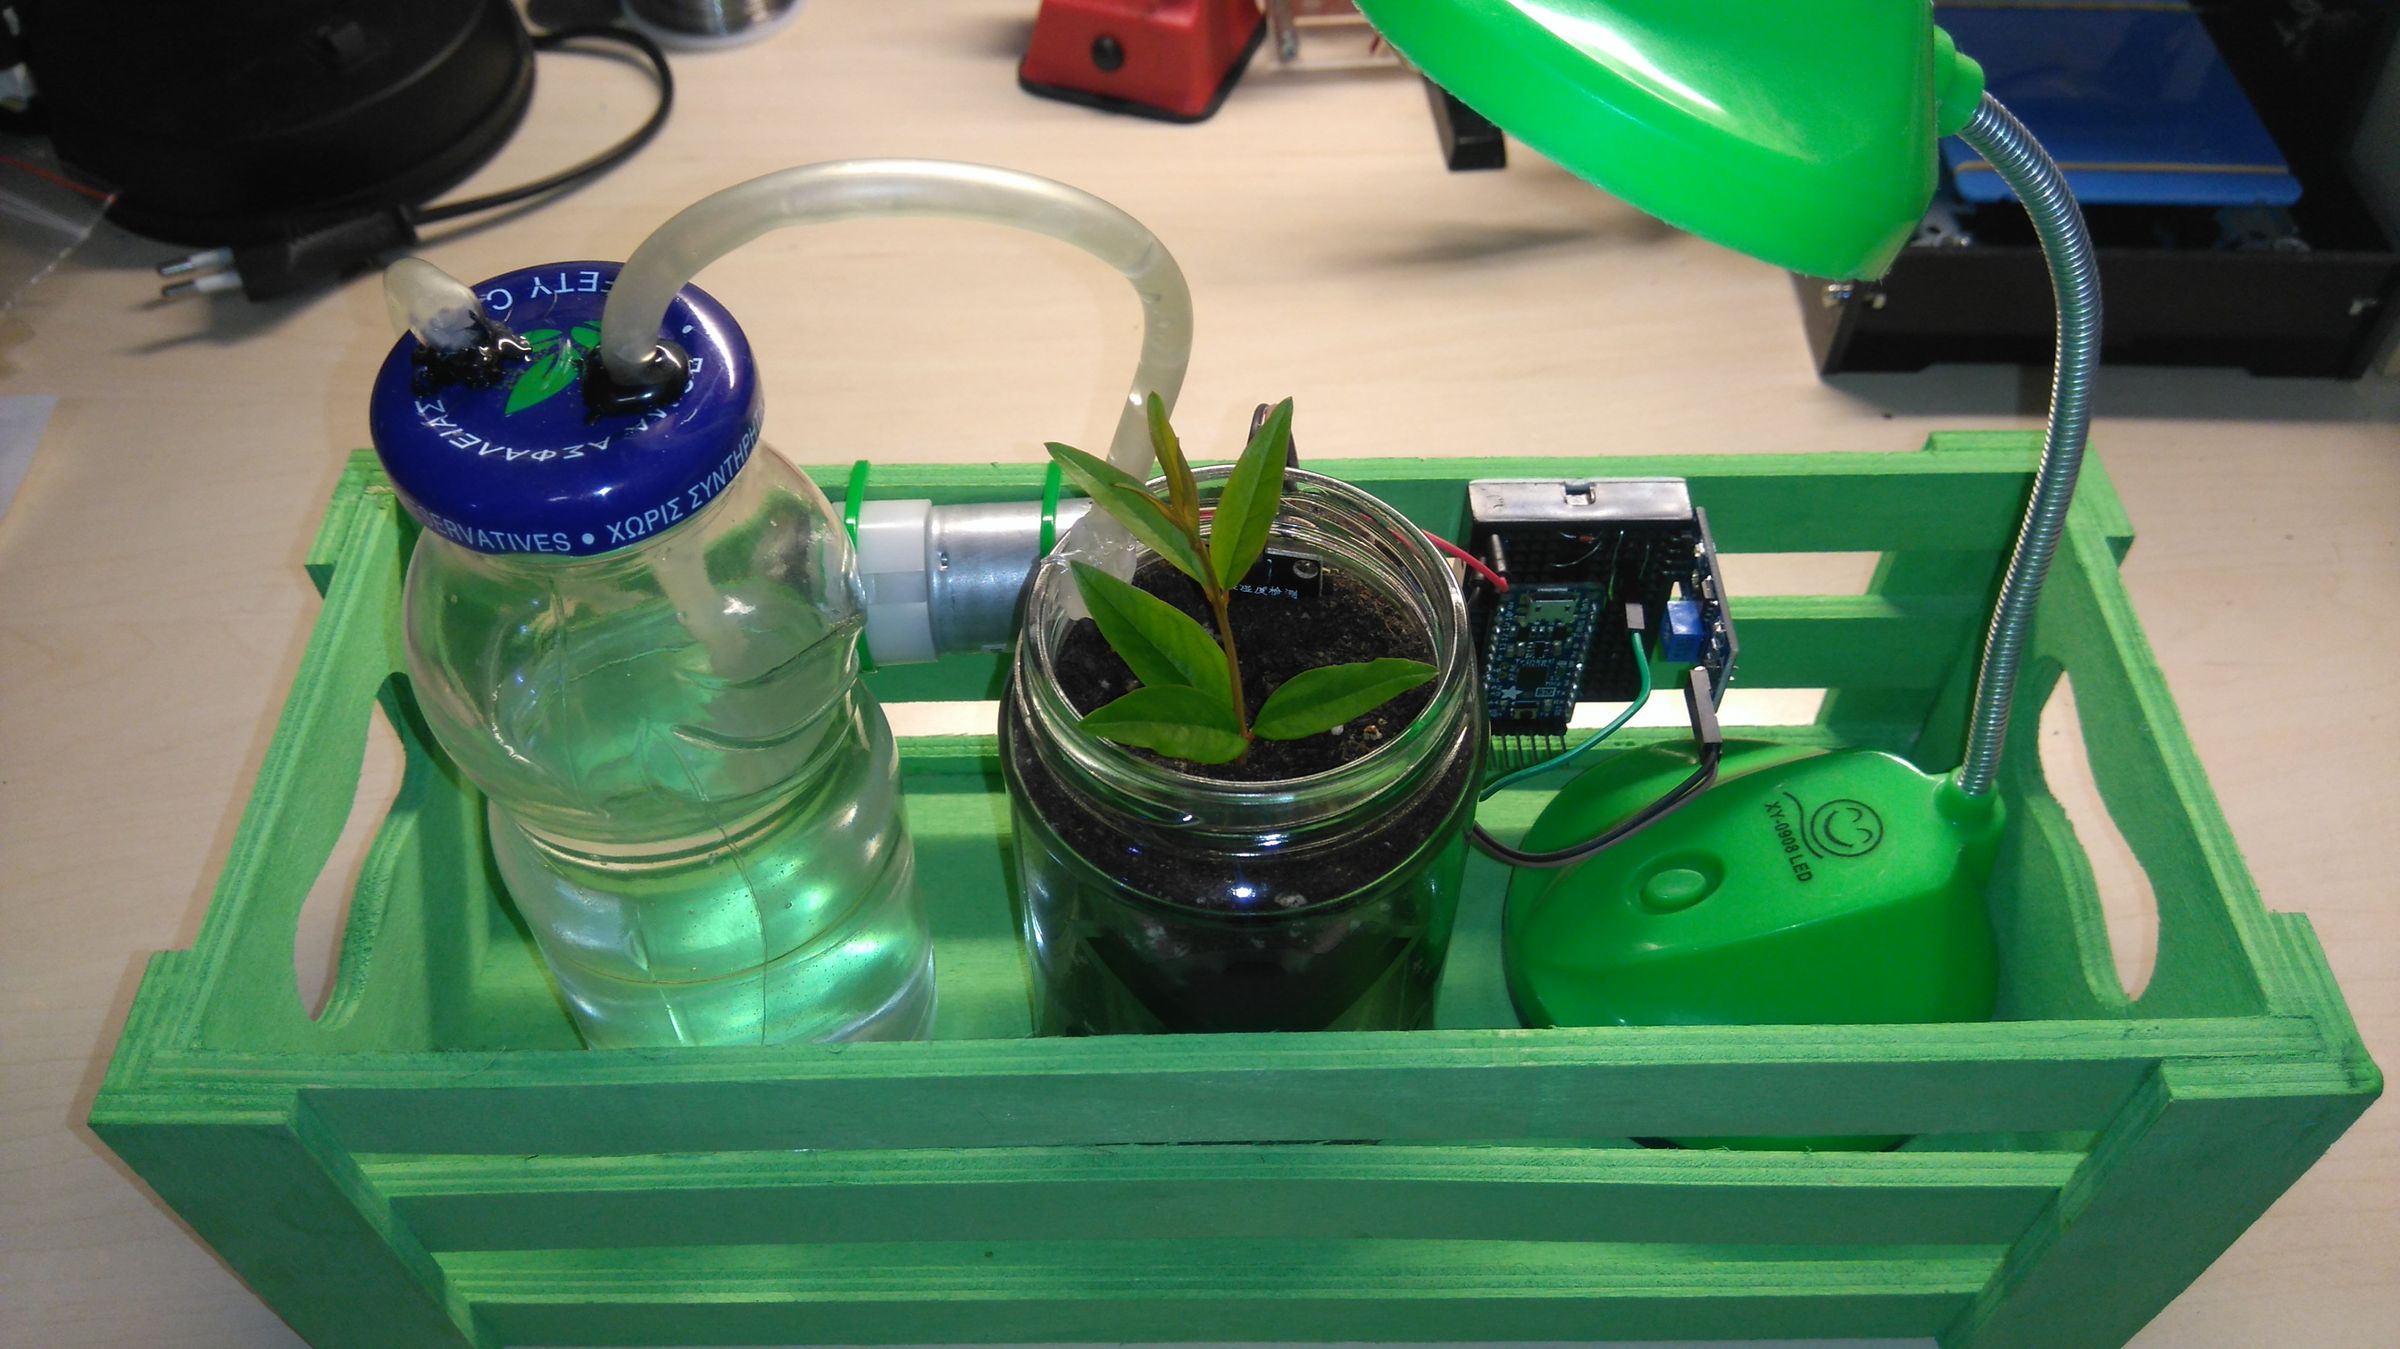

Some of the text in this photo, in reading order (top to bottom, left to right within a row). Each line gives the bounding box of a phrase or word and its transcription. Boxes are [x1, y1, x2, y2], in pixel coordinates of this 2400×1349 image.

[606, 496, 684, 544] ΧΩΡΙΣ
[1764, 801, 1814, 882] XY-0908 LED
